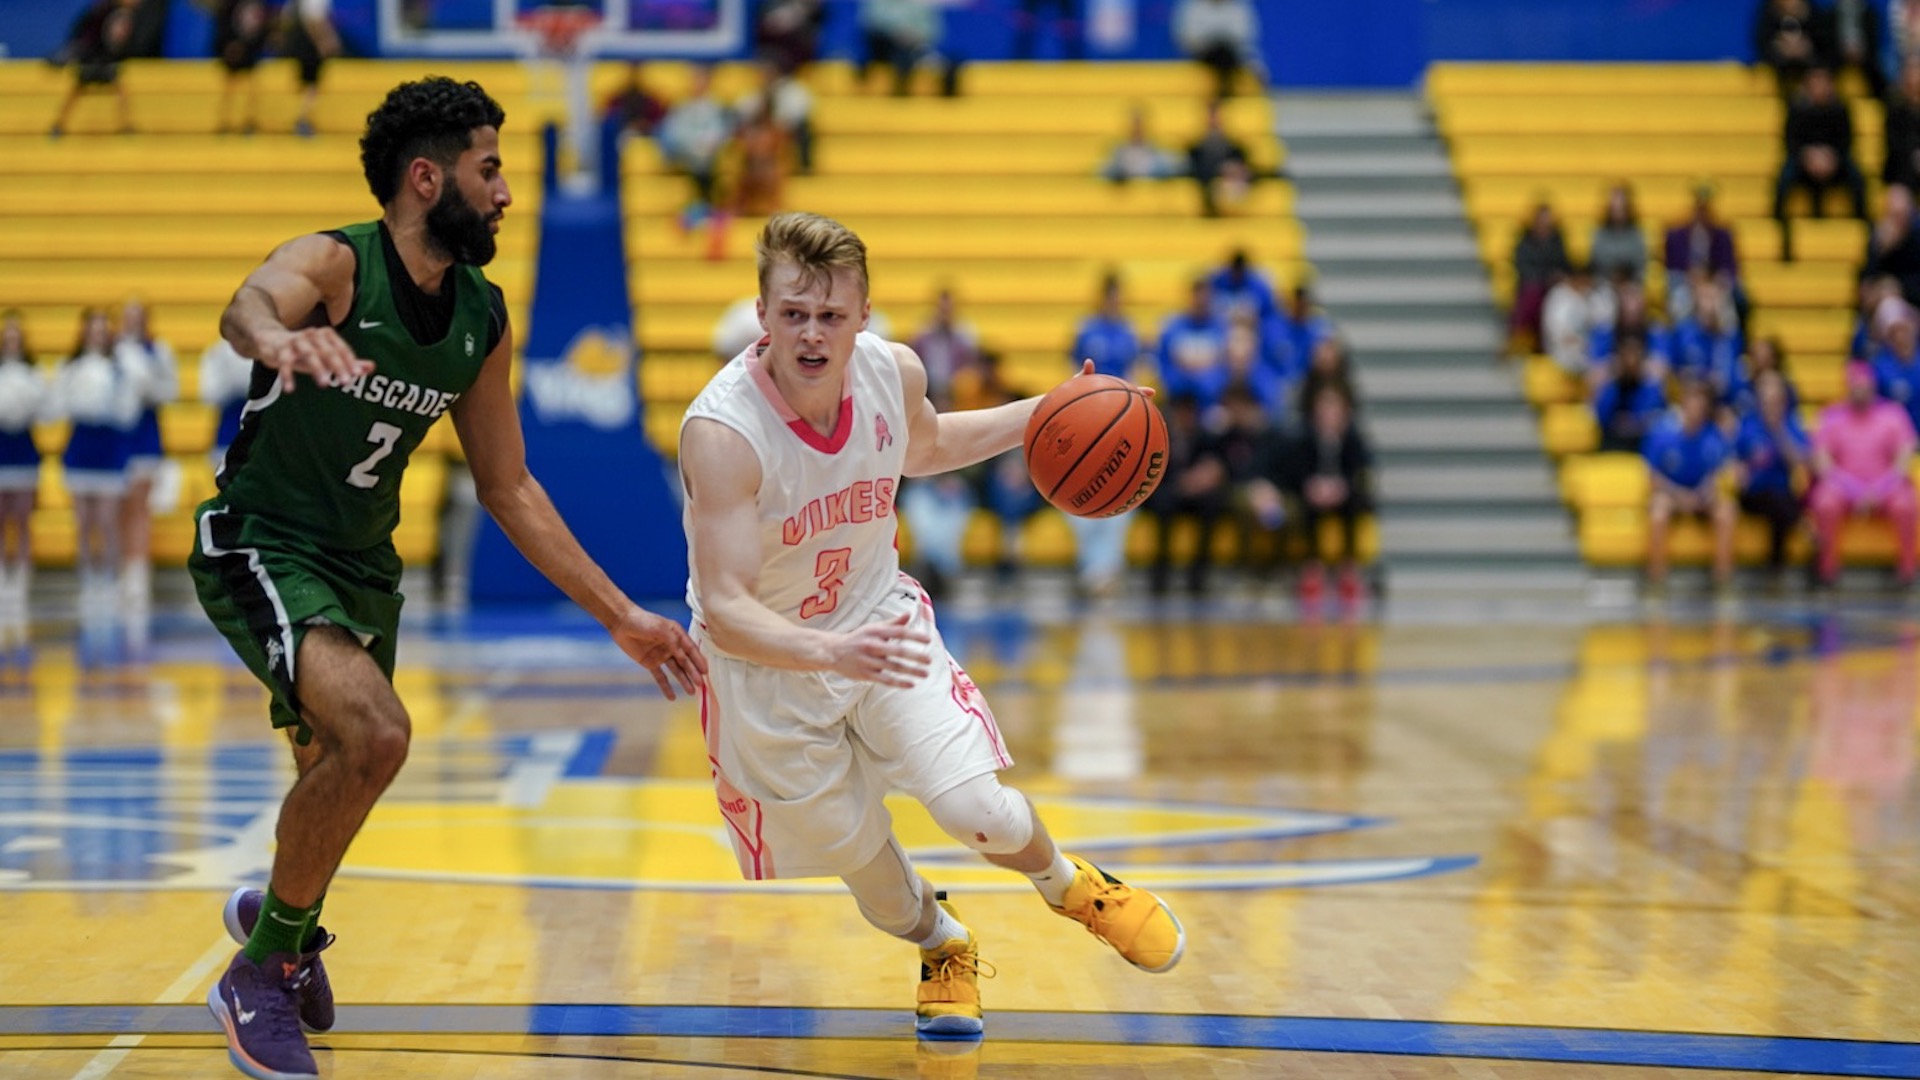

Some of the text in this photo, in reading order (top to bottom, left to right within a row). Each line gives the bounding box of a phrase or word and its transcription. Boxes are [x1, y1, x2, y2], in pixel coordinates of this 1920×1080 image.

[329, 374, 460, 418] ASCADE
[346, 421, 402, 488] 2
[1071, 440, 1131, 508] EVOLUTION
[783, 478, 893, 545] VIKES
[800, 547, 851, 619] 3
